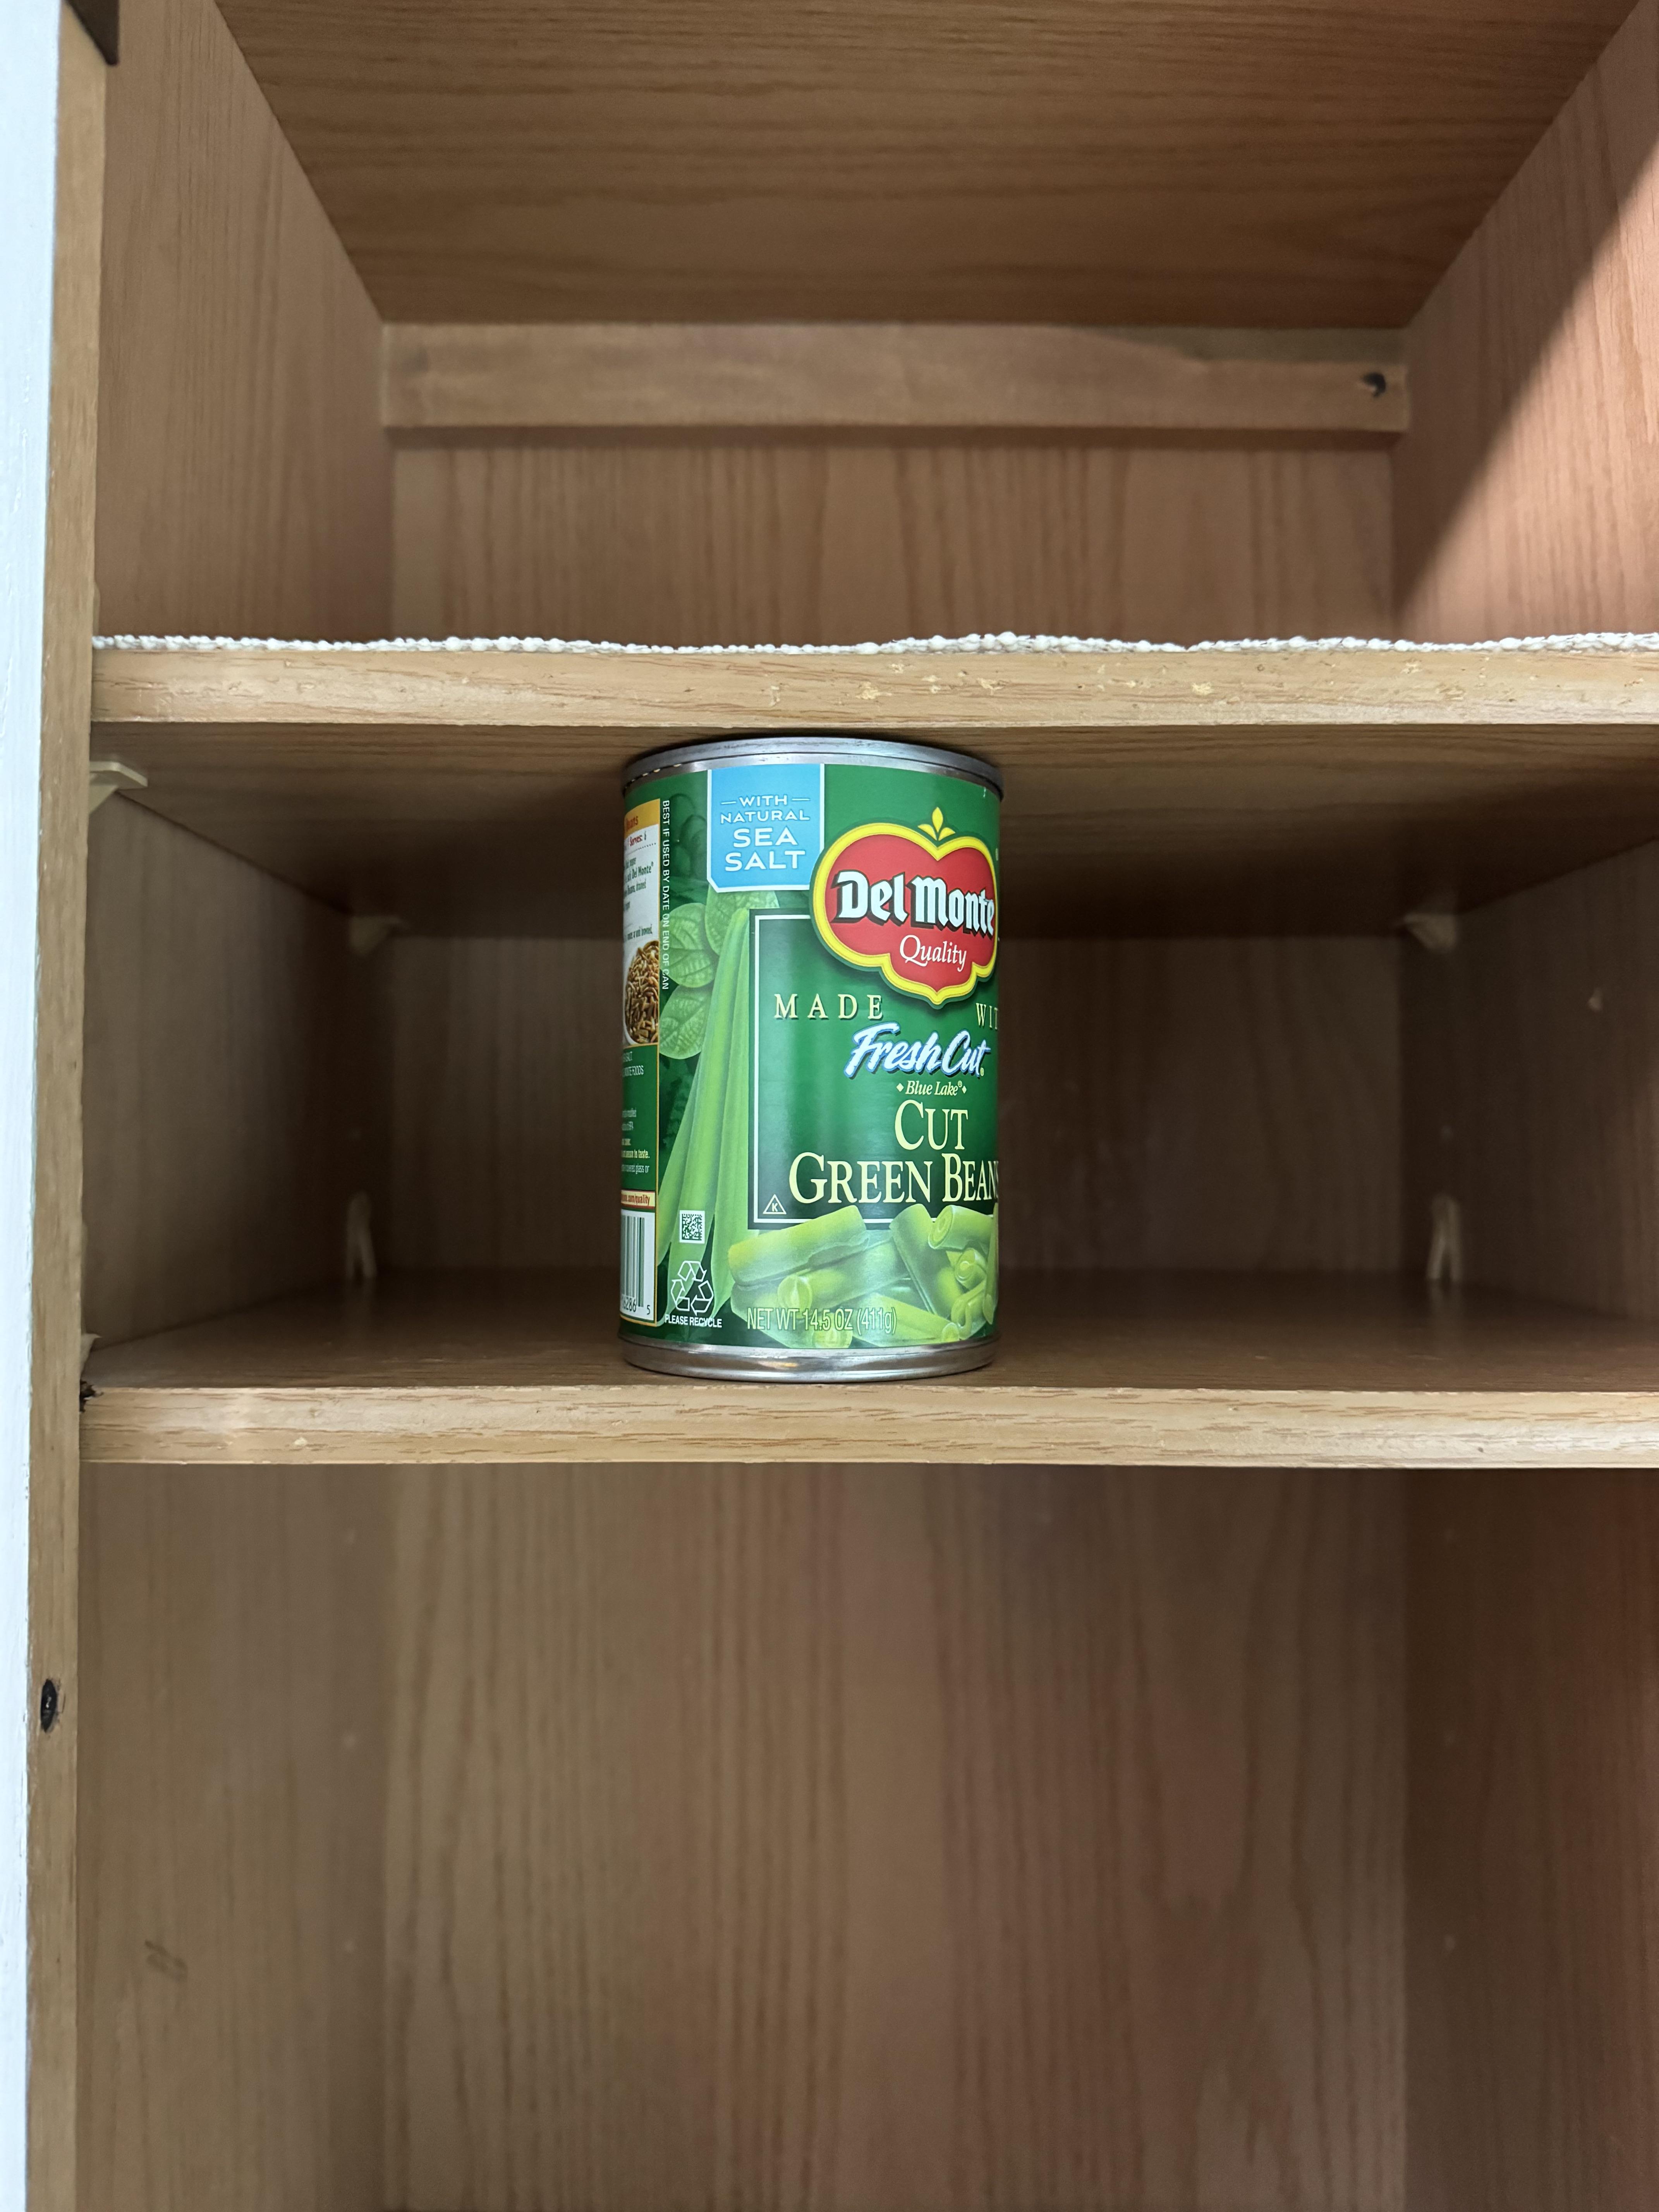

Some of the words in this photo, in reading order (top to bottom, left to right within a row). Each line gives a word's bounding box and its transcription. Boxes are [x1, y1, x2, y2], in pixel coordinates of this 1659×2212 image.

[739, 795, 787, 807] WITH
[720, 810, 810, 824] NATURAL
[663, 828, 670, 837] IF
[733, 827, 798, 848] SEA
[725, 850, 805, 872] SALT
[663, 869, 670, 883] BY
[833, 870, 908, 924] Del
[908, 876, 995, 937] Monte
[663, 913, 670, 927] ON
[662, 953, 669, 966] OF
[900, 934, 967, 972] Quality
[774, 993, 883, 1020] MADE
[843, 1021, 942, 1079] Fresh
[905, 1080, 932, 1095] Blue
[895, 1099, 968, 1150] CUT
[638, 1149, 650, 1159] taste.
[789, 1152, 933, 1204] GREEN
[647, 1304, 651, 1315] 5
[665, 1314, 688, 1325] PLEASE
[689, 1316, 722, 1328] RECYCLE
[747, 1307, 773, 1331] NET
[776, 1307, 801, 1331] WT
[803, 1307, 831, 1331] 14.5
[834, 1307, 853, 1331] OZ
[856, 1307, 896, 1335] (411g)
